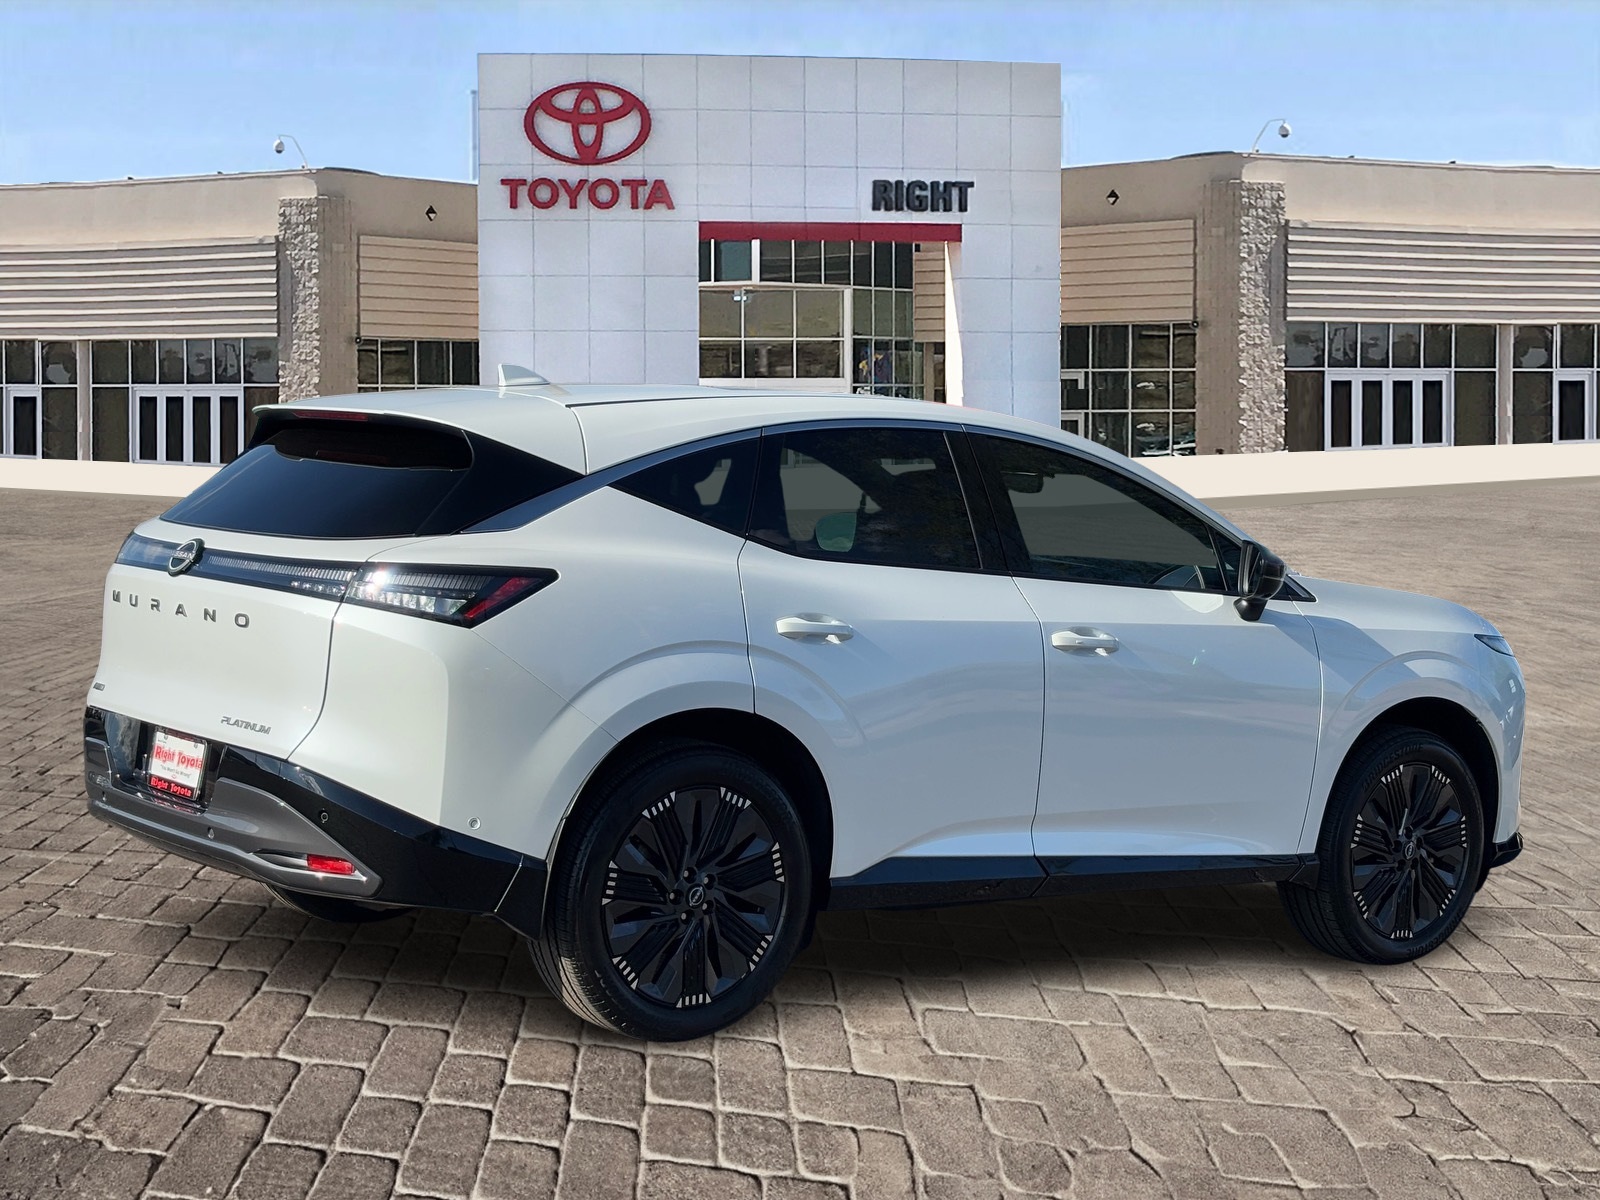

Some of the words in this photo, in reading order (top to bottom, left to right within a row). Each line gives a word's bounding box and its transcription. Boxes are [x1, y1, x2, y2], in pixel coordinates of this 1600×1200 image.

[500, 178, 675, 209] TOYOTA
[872, 179, 974, 212] RIGHT
[112, 589, 249, 628] MURANO
[221, 716, 271, 734] PLATINUM
[154, 745, 175, 763] Right
[177, 751, 203, 769] Toyota
[151, 777, 169, 789] Right
[170, 783, 192, 797] Toyota
